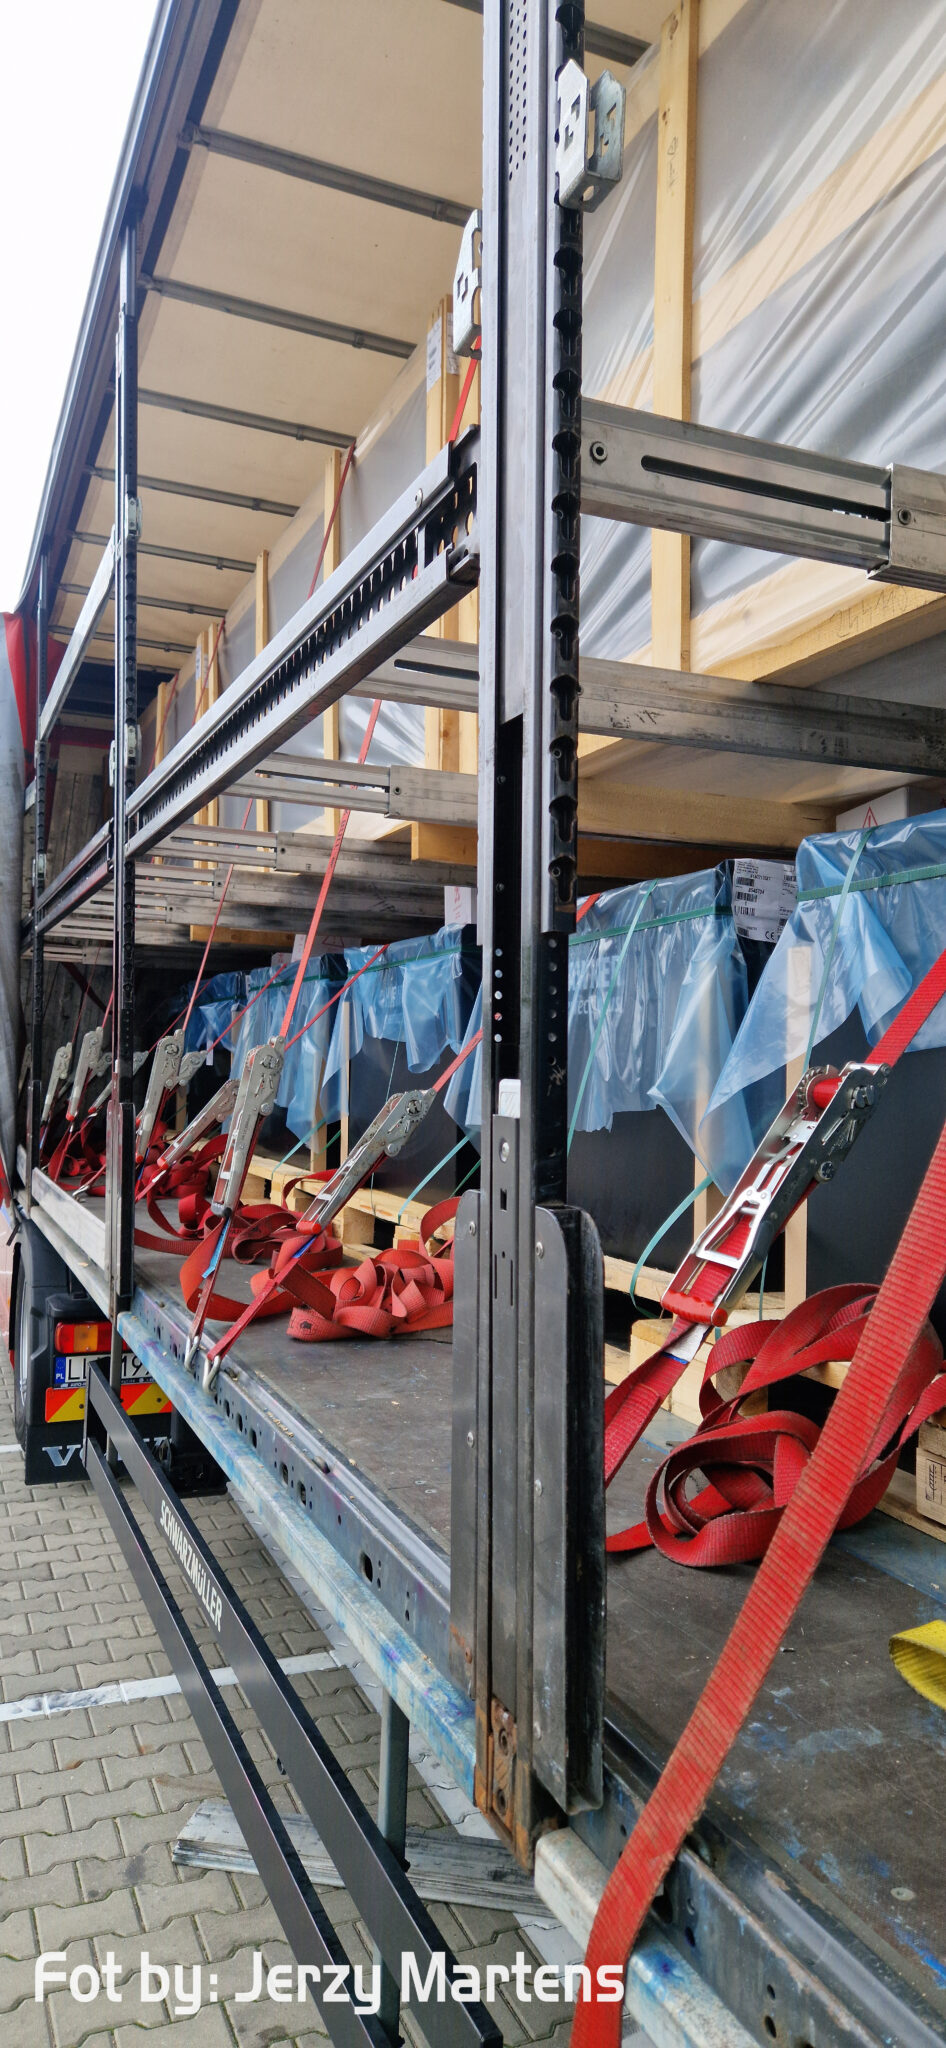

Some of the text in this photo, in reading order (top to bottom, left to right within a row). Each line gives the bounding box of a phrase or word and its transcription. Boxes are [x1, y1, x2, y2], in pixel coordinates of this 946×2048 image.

[55, 1372, 65, 1380] PL
[121, 1355, 150, 1377] 19
[160, 1499, 223, 1633] SCHWARZMÜLLER
